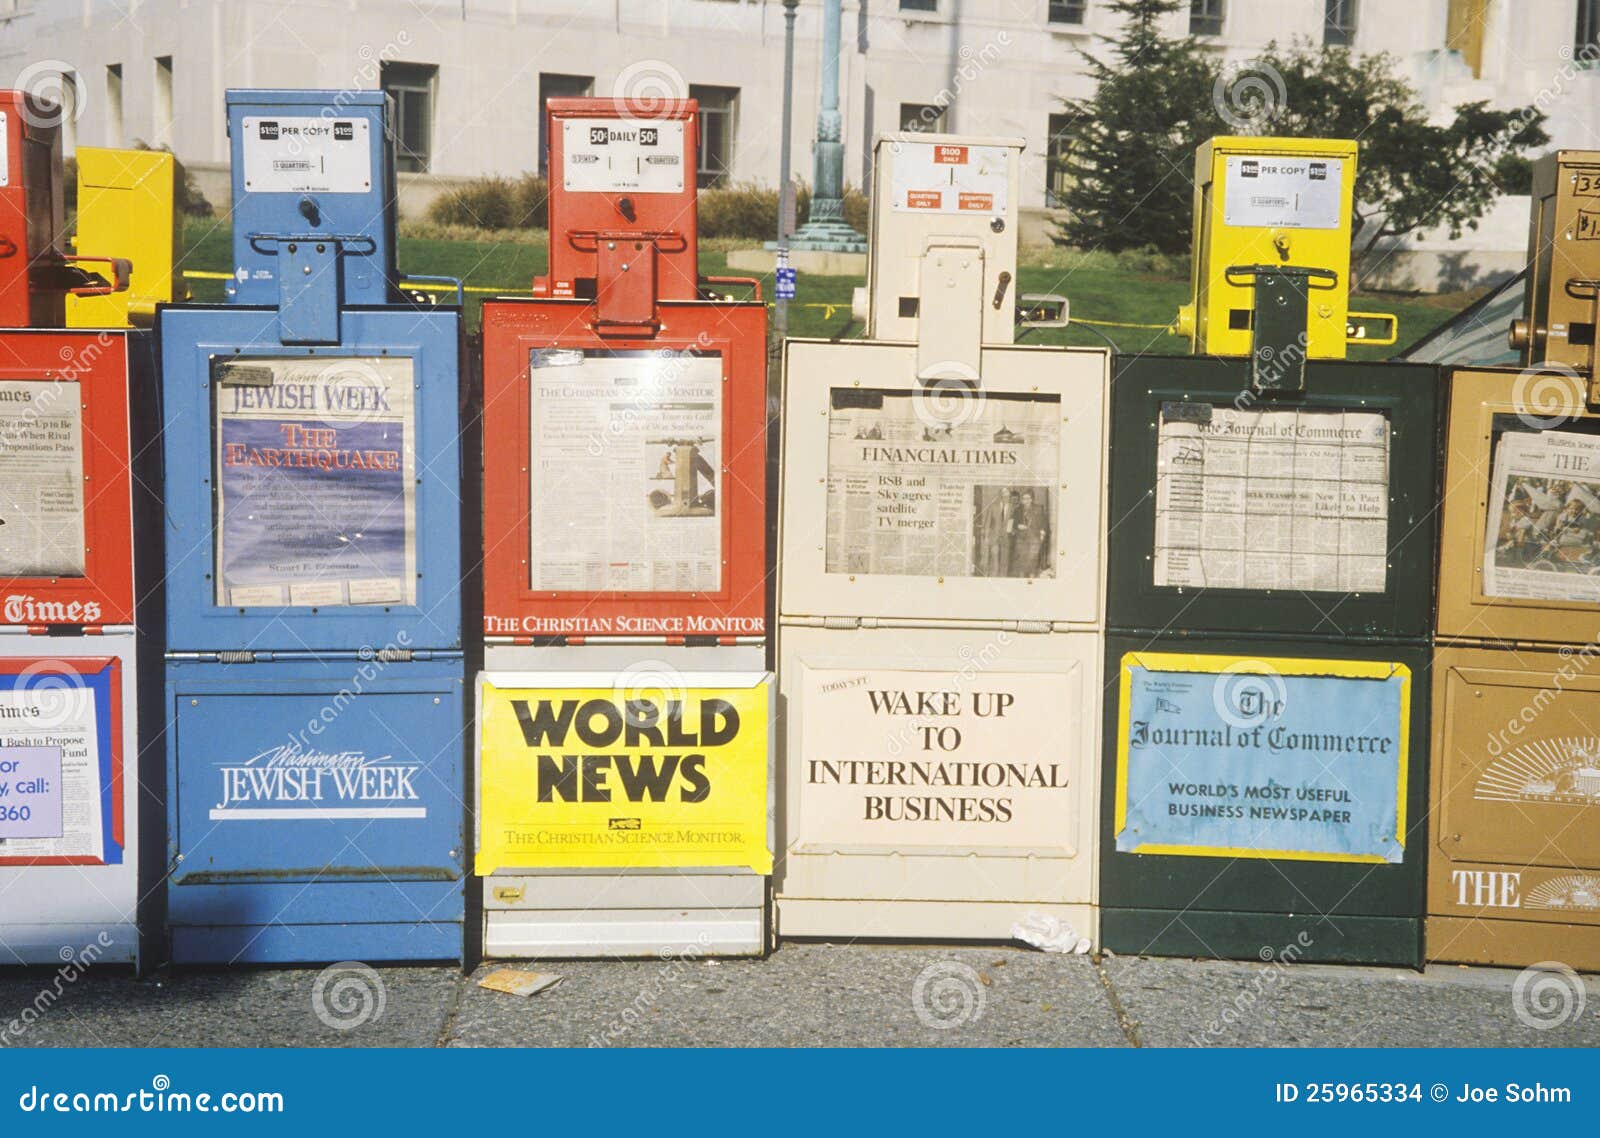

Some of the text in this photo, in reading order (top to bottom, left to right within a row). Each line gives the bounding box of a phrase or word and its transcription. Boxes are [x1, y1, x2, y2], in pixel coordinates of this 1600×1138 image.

[282, 127, 299, 135] PER
[610, 132, 636, 141] DAILY
[1262, 166, 1277, 174] PER
[1281, 167, 1305, 175] COPY
[233, 384, 390, 414] JEWISH WEEK
[48, 431, 71, 440] Rival
[225, 443, 399, 473] EARTHQUAKE
[862, 447, 1017, 465] FINANCIAL TIMES
[1553, 453, 1590, 471] THE
[878, 475, 926, 486] BSB and
[877, 489, 932, 502] Sky agree
[876, 504, 918, 514] satellite
[897, 519, 935, 529] merger
[4, 595, 101, 623] Times
[484, 616, 765, 632] THE CHRISTIAN SCIENCE MONITOR
[867, 690, 1015, 717] WAKE UP
[1240, 690, 1285, 718] The
[510, 698, 740, 748] WORLD
[7, 736, 85, 747] Bush to Propose
[917, 726, 962, 751] TO
[1131, 721, 1393, 755] Journal of Commerce
[62, 748, 88, 759] Fund
[245, 743, 391, 776] Washington
[537, 754, 711, 803] NEWS
[807, 759, 1069, 788] INTERNATIONAL
[16, 778, 50, 793] call:
[216, 766, 420, 809] JEWISH WEEK
[1169, 782, 1352, 803] WORLD'S MOST USEFUL
[864, 796, 1012, 823] BUSINESS
[1169, 803, 1352, 823] BUSINESS NEWSPAPER
[504, 830, 535, 845] THE
[537, 830, 614, 845] CHRISTIAN
[616, 829, 674, 845] SCIENCE
[1452, 869, 1521, 908] THE
